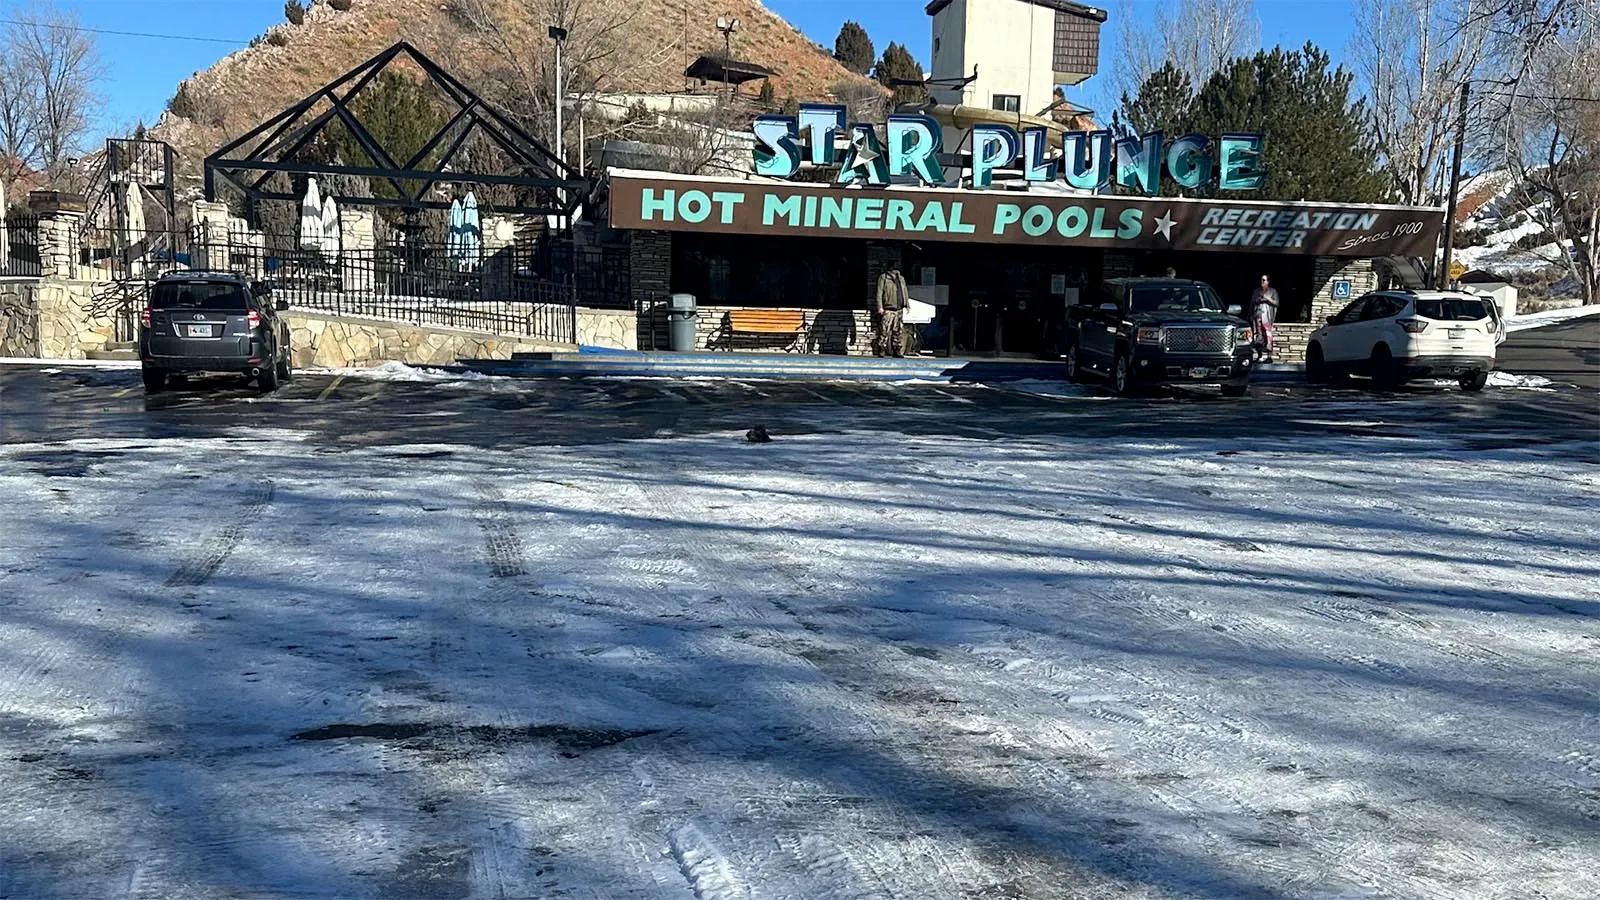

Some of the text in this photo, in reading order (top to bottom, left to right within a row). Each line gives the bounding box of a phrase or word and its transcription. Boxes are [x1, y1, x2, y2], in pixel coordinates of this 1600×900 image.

[753, 104, 1264, 195] STAR PLUNGE
[641, 187, 1144, 240] HOT MINERAL POOLS
[1200, 206, 1380, 231] RECREATION
[1196, 227, 1307, 248] CENTER
[1392, 221, 1423, 238] 1900
